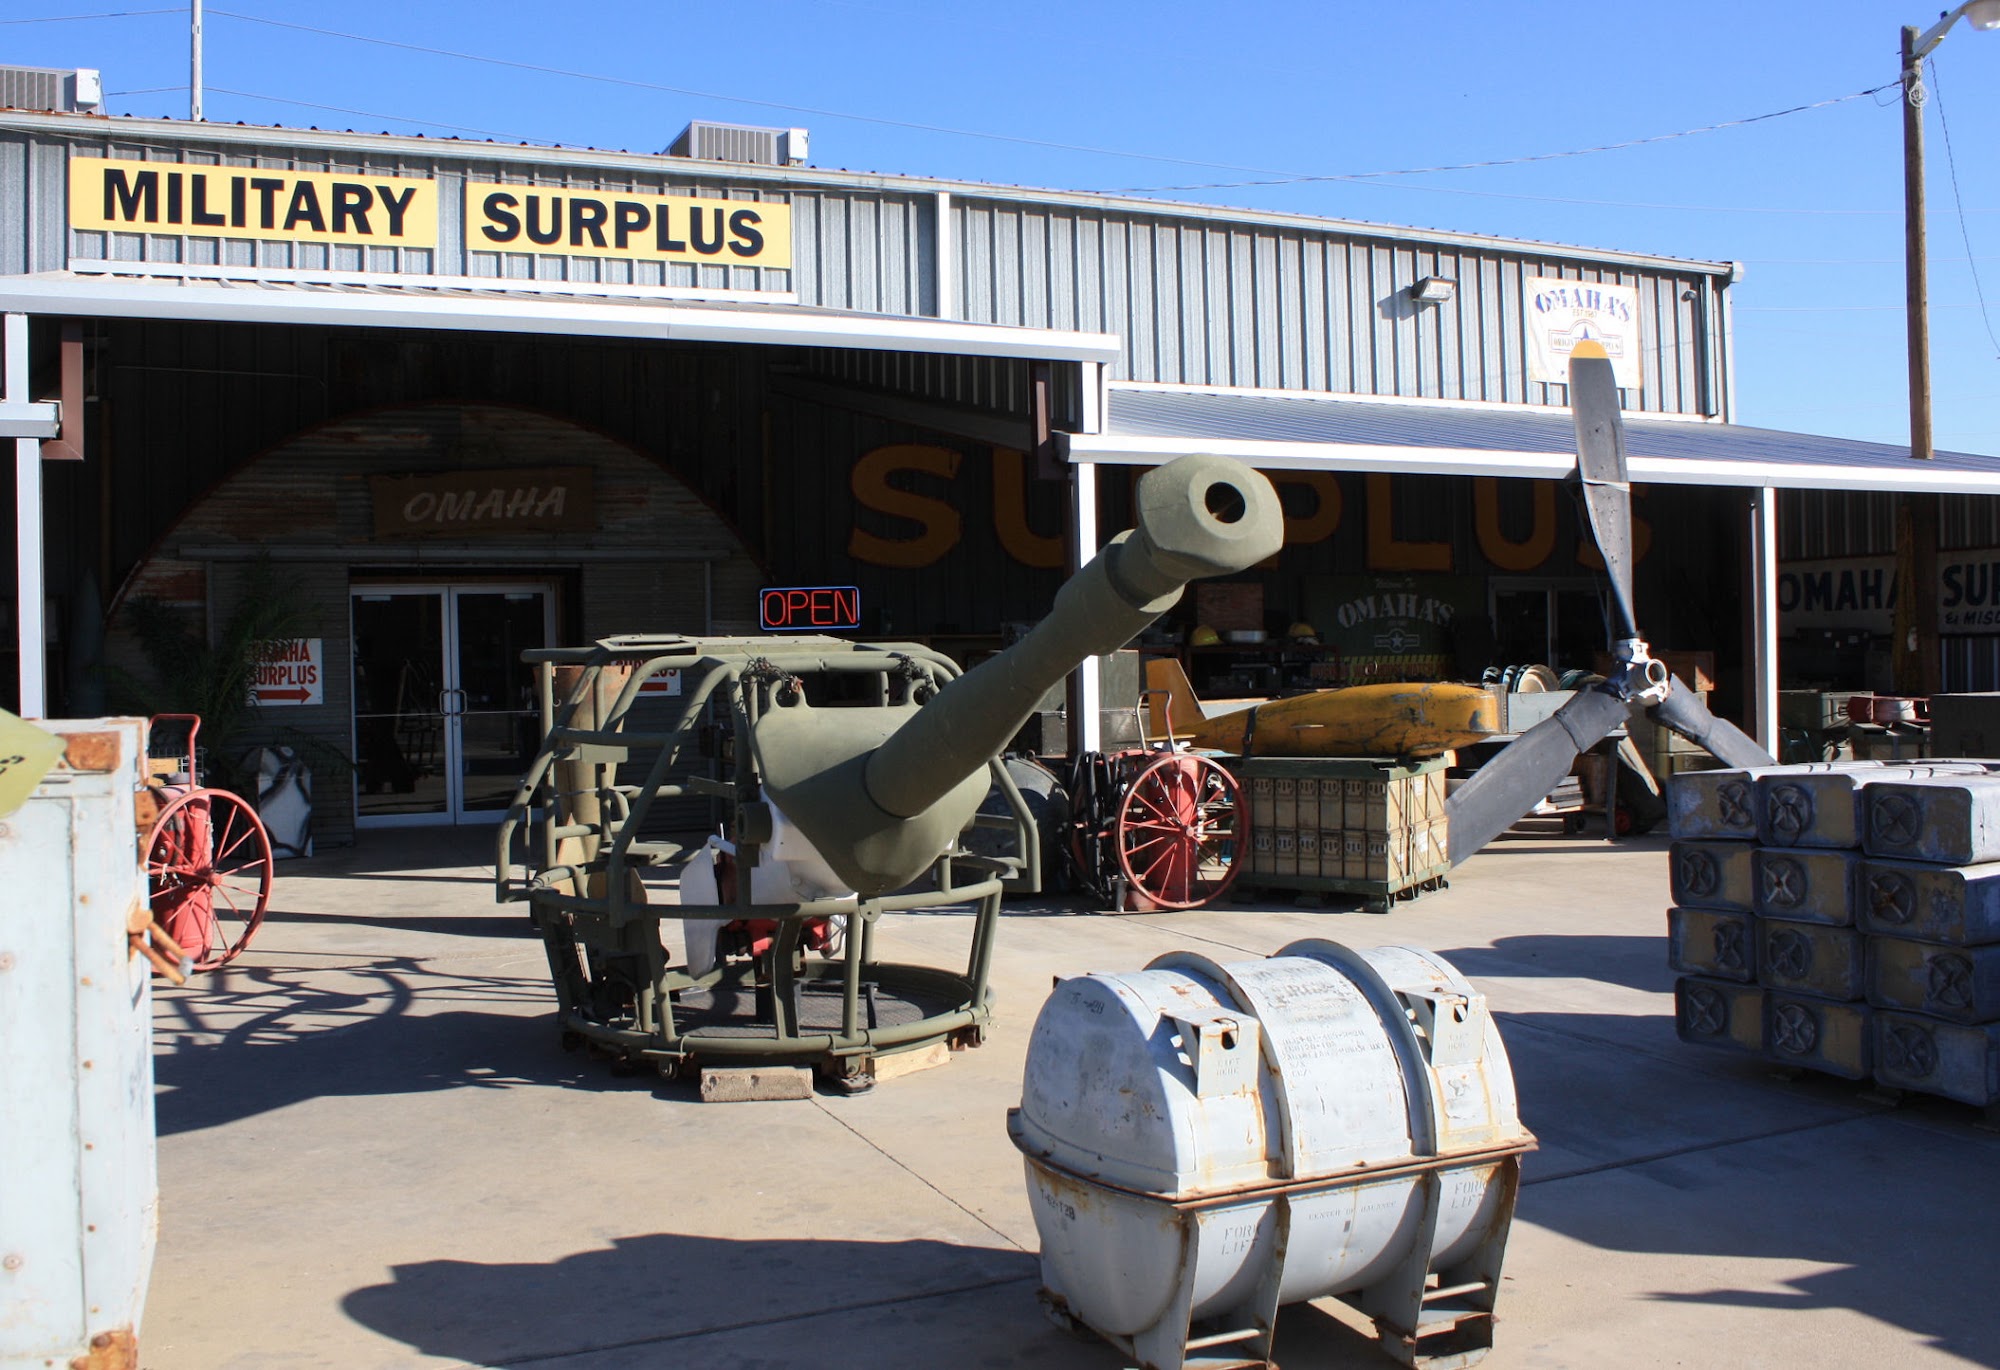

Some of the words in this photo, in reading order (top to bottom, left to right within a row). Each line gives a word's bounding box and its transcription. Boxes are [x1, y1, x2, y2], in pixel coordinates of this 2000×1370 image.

[103, 167, 417, 237] MILITARY
[482, 192, 764, 257] SURPLUS
[403, 486, 567, 523] OMAHA
[848, 441, 1653, 574] SUPLU
[764, 591, 857, 626] OPEN
[1337, 594, 1455, 629] OMAHA'S
[255, 641, 310, 663] AHA
